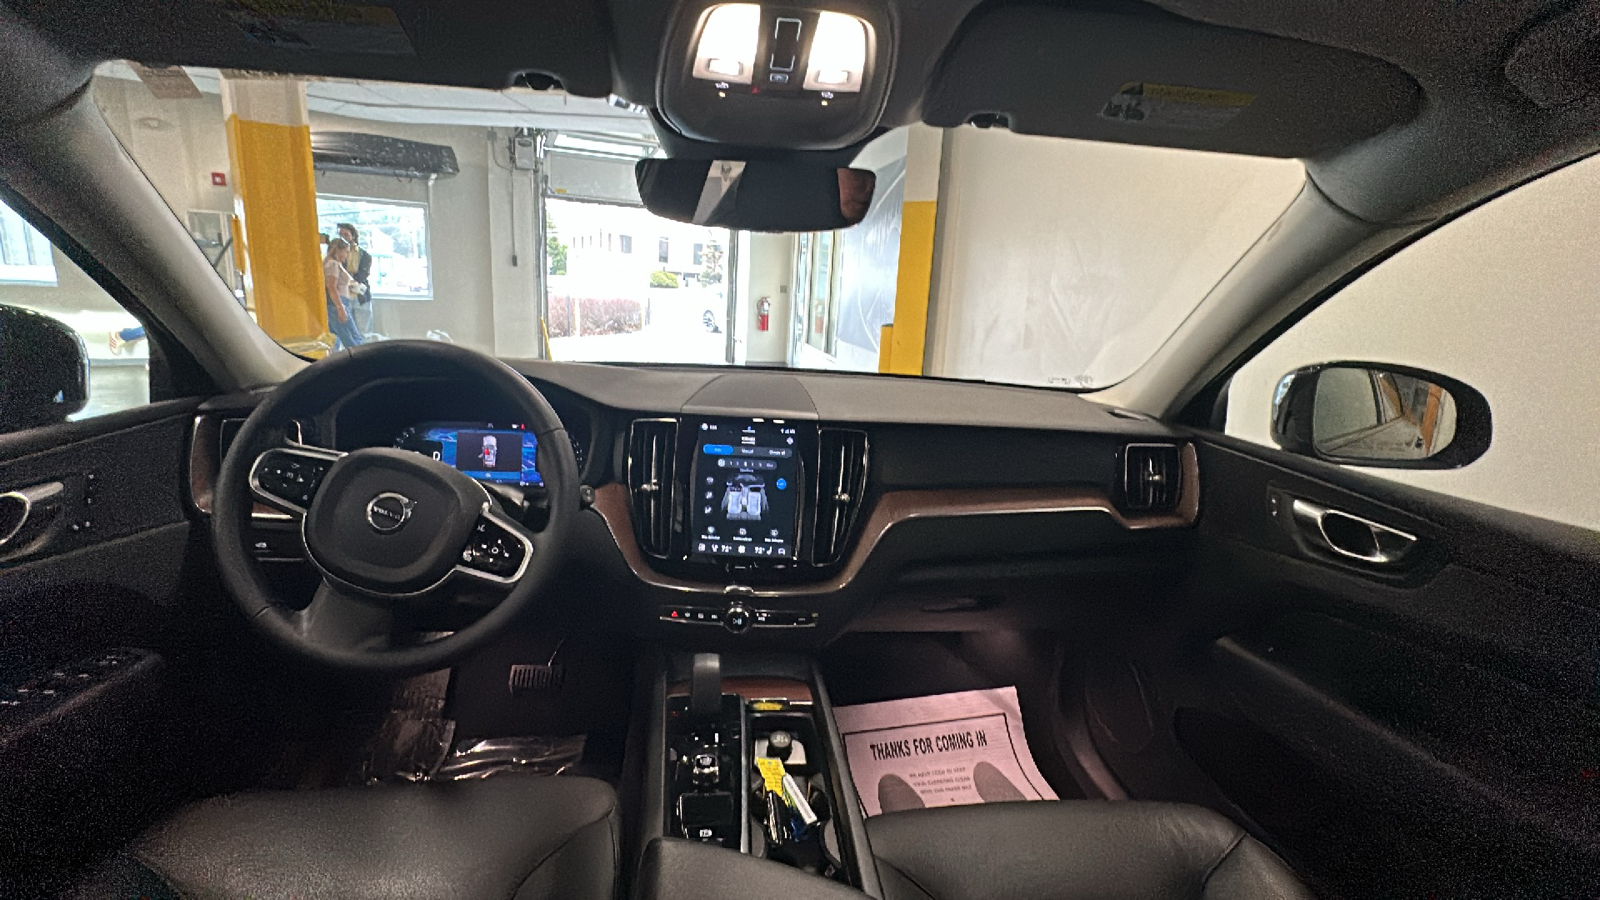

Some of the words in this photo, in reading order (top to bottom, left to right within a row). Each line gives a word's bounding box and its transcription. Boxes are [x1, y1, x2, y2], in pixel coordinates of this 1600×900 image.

[870, 740, 911, 761] THANKS
[913, 737, 934, 756] FOR
[935, 731, 974, 753] COMING
[975, 729, 987, 747] IN
